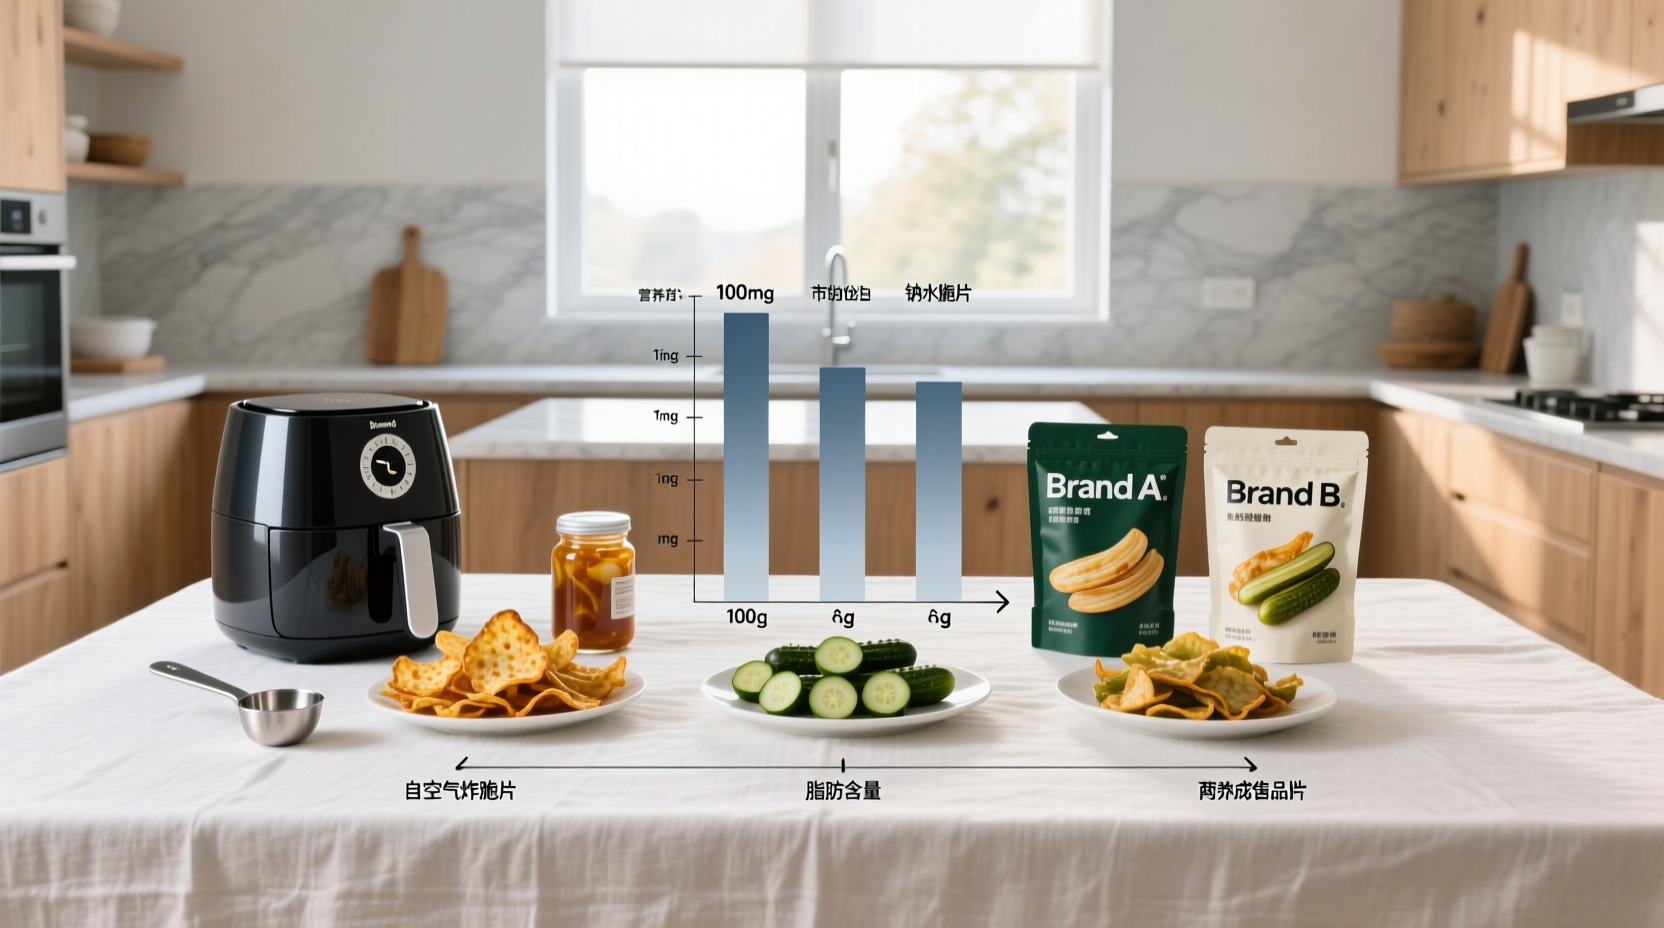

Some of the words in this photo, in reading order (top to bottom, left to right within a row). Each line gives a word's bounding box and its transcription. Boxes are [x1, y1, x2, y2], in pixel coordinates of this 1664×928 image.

[1046, 472, 1134, 500] Brand
[1137, 474, 1162, 501] A
[1227, 479, 1314, 506] Brand
[1320, 482, 1341, 507] B
